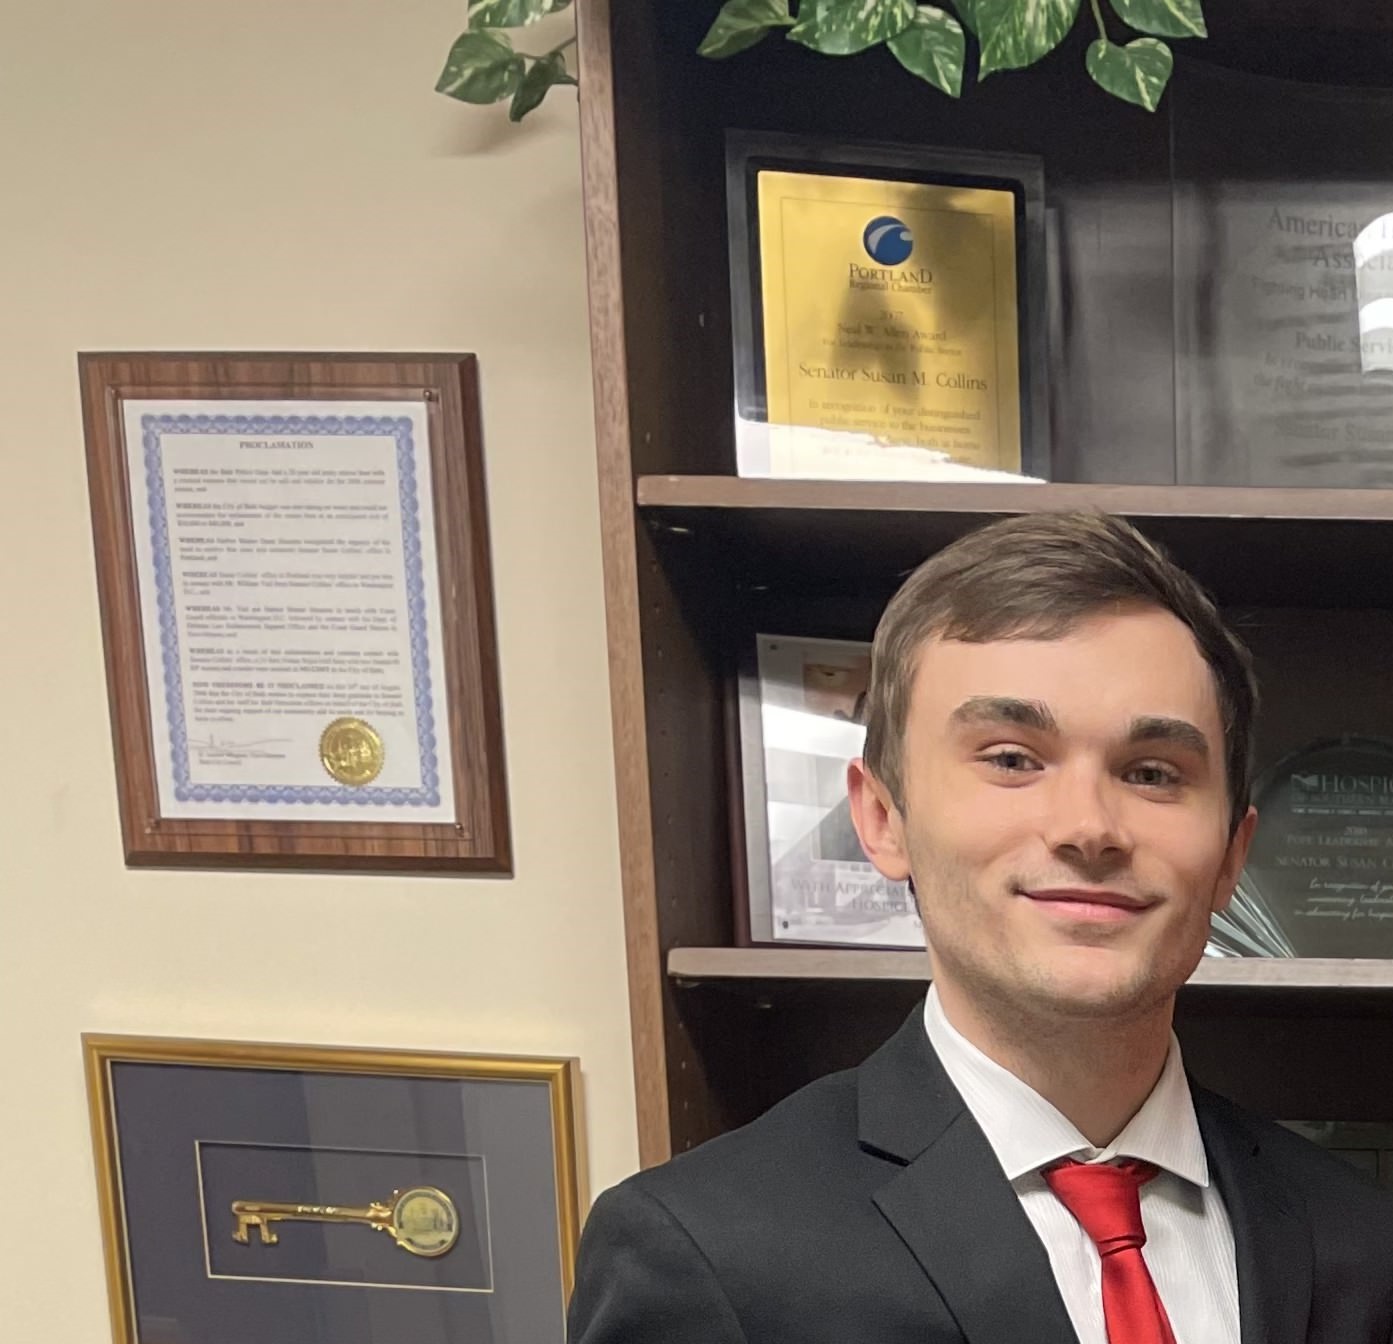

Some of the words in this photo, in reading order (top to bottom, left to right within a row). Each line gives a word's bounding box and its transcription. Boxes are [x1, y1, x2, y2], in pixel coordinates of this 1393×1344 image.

[849, 263, 933, 284] PORTLAND
[799, 361, 857, 381] Senator
[862, 367, 907, 385] Susan
[935, 372, 988, 391] Collins
[239, 440, 314, 450] PROCLAMATION
[836, 880, 906, 897] APPRECIAT
